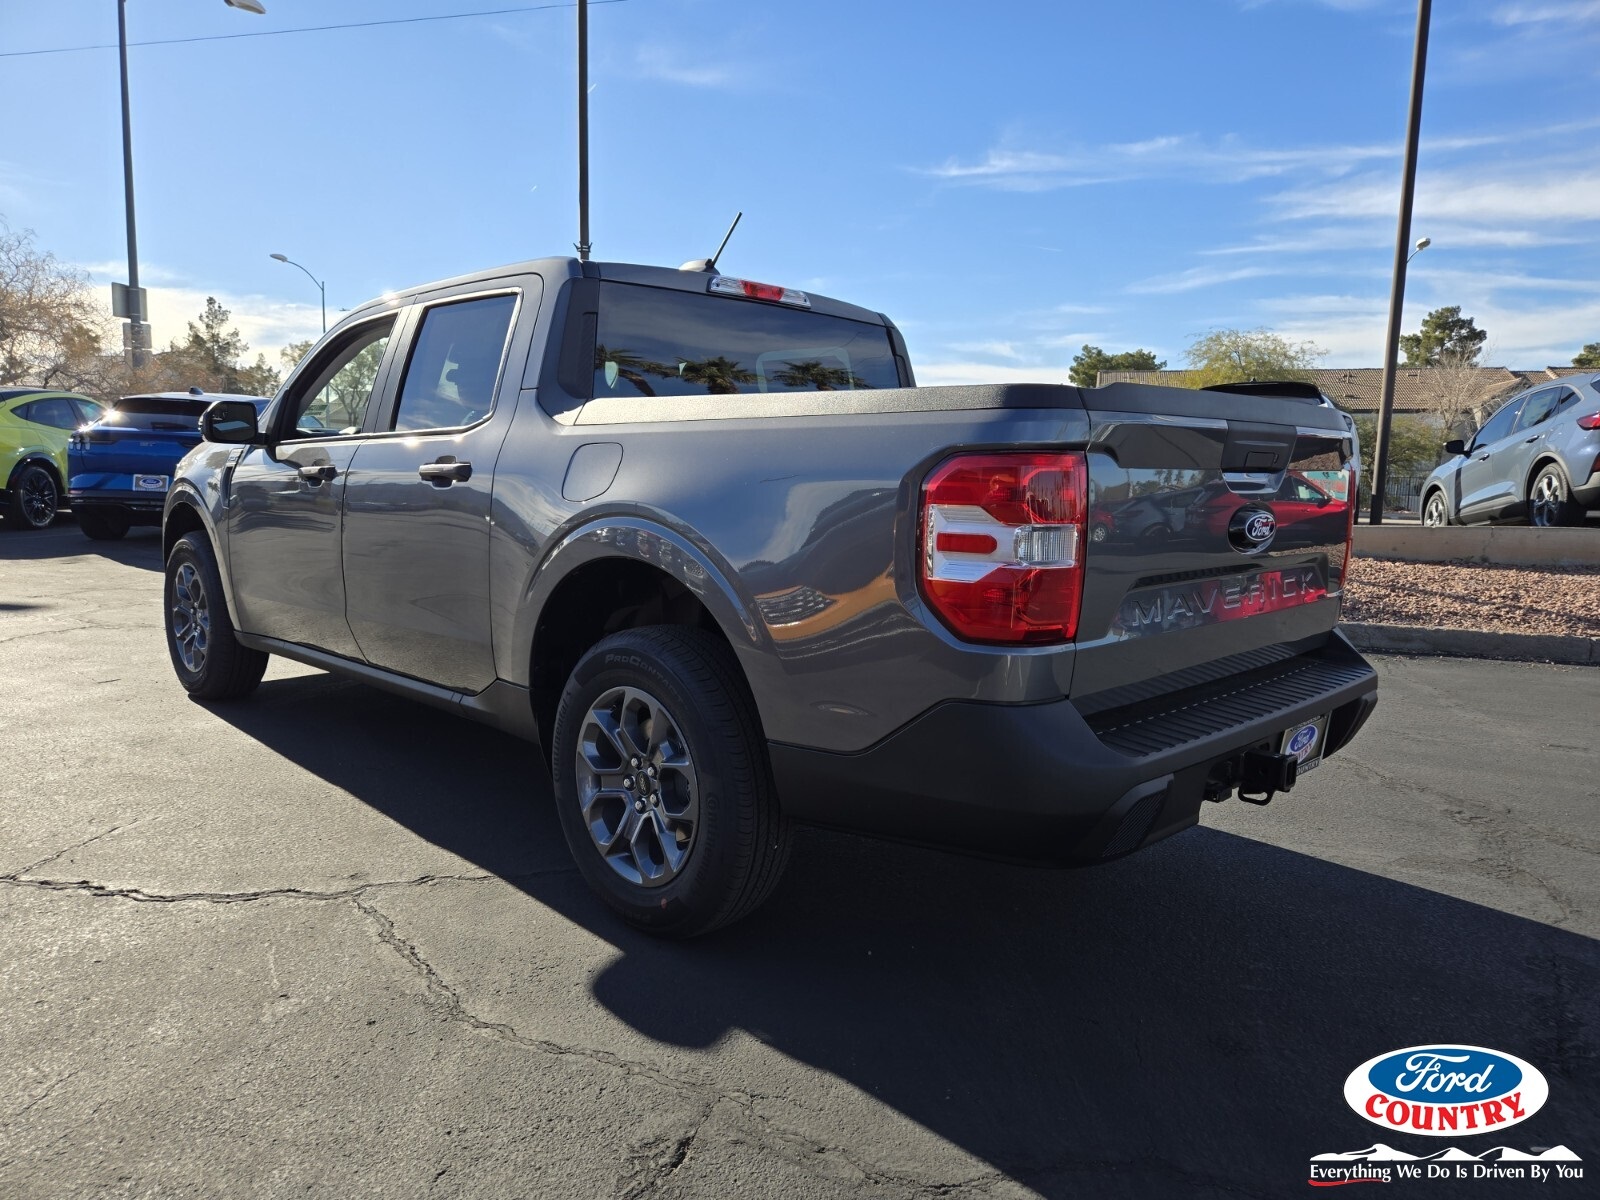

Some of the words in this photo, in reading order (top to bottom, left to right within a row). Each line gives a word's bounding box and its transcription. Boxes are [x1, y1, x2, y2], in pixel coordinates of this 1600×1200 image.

[1251, 516, 1272, 537] Ford
[1131, 571, 1315, 627] MAVERICK
[1293, 728, 1312, 751] Ford
